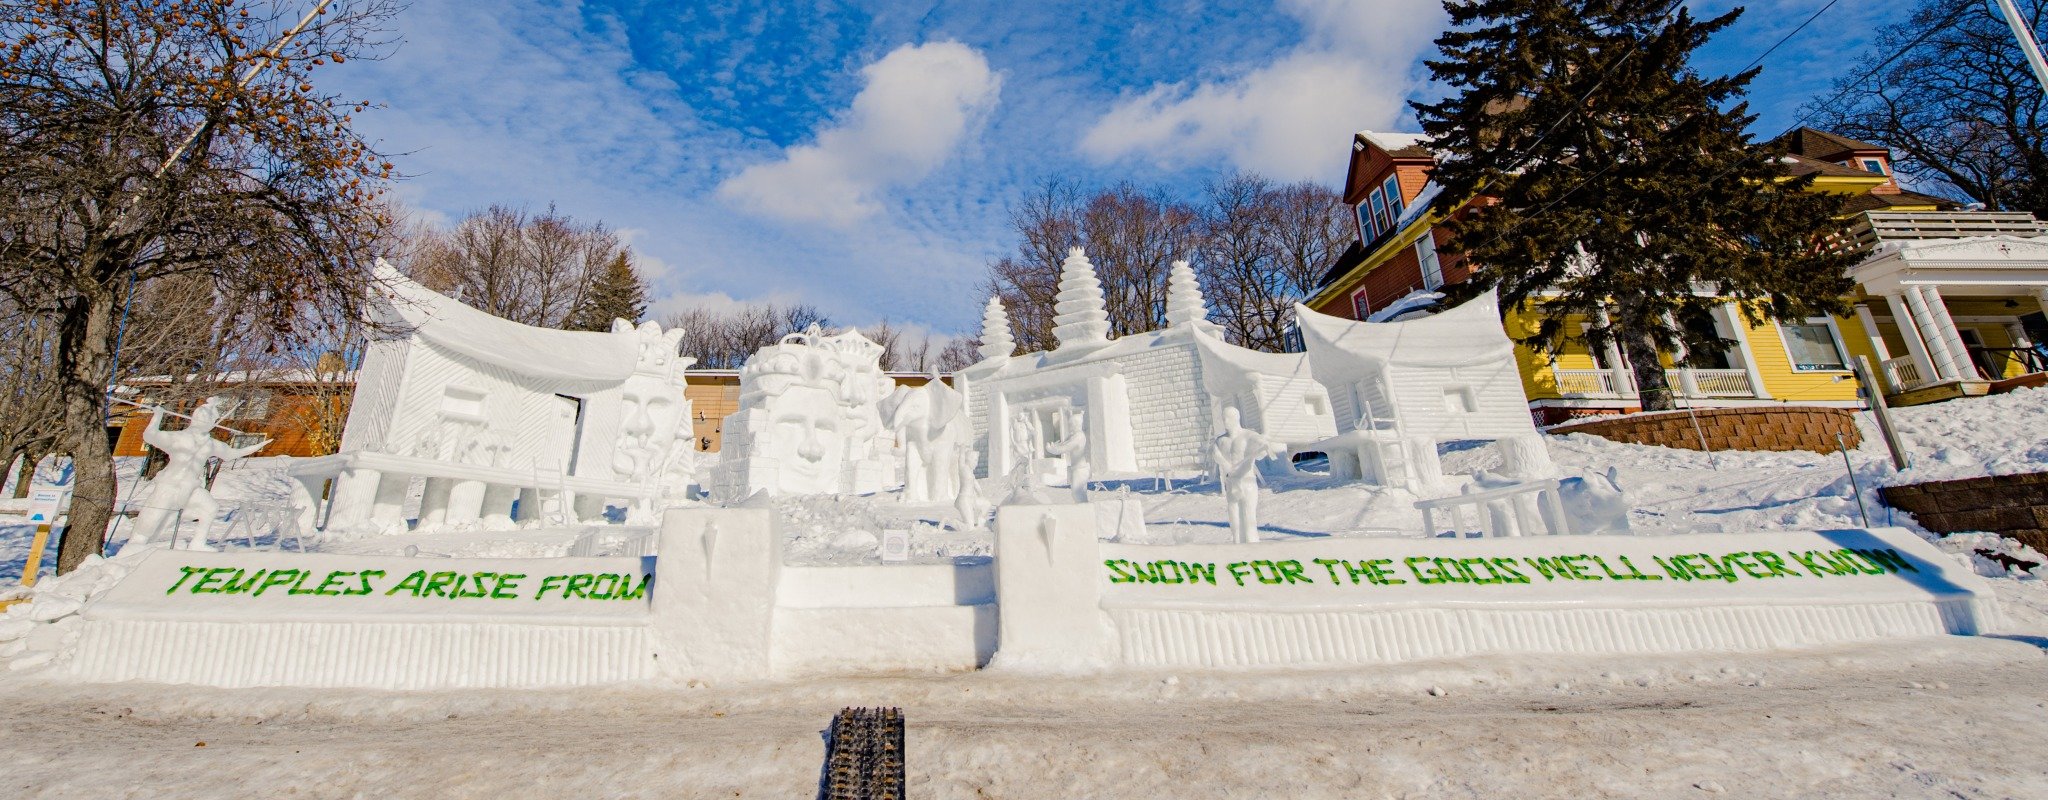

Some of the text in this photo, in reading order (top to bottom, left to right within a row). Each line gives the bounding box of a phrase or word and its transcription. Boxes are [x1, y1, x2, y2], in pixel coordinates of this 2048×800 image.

[166, 566, 653, 601] TEMPLES ARISE FROM
[1104, 558, 1217, 586] SNOW
[1226, 559, 1314, 587] FOR
[1313, 558, 1407, 586] THE
[1653, 550, 1802, 583] NEVER
[1788, 548, 1919, 578] KNOW
